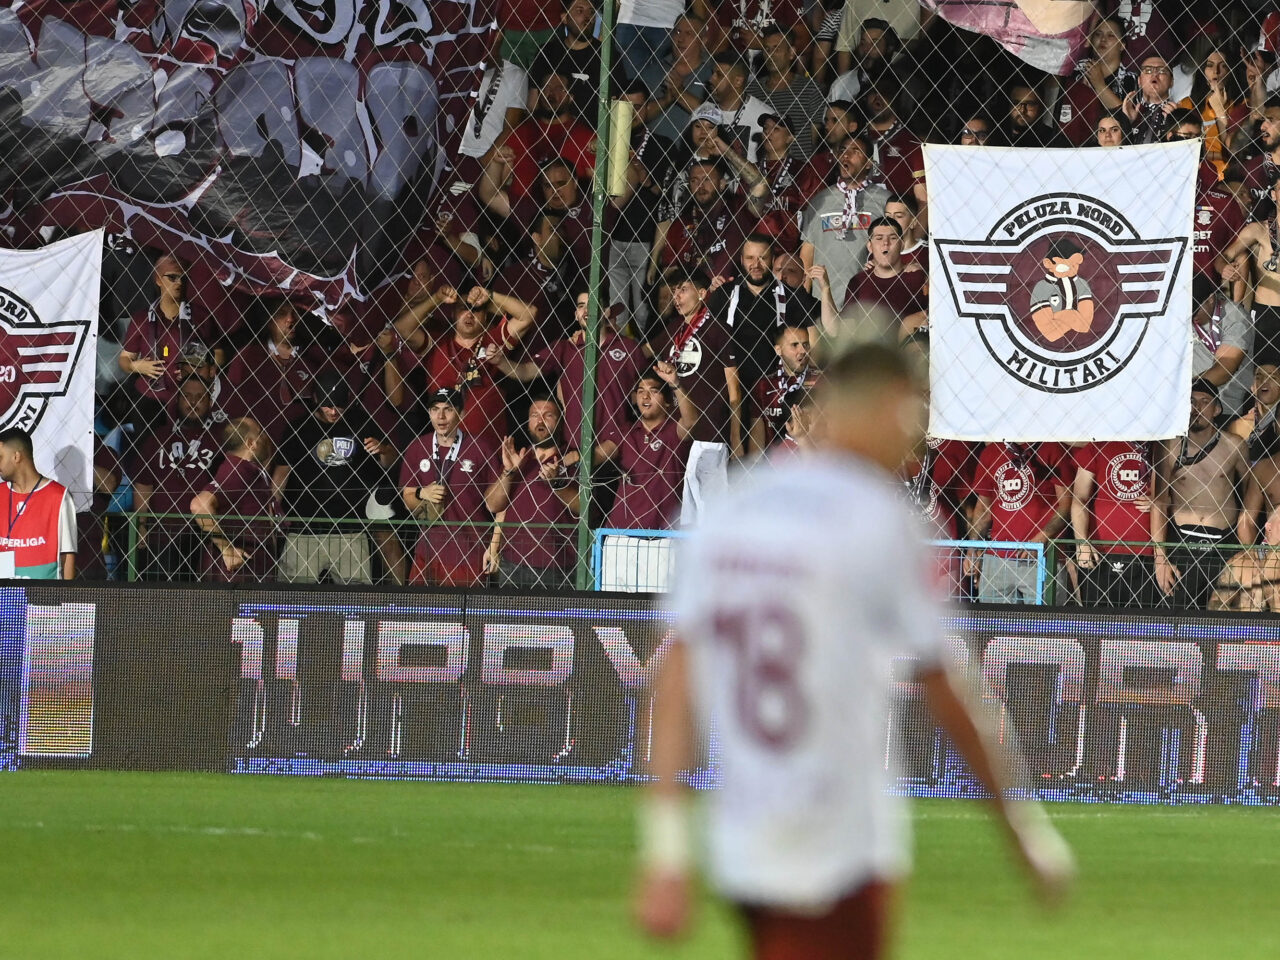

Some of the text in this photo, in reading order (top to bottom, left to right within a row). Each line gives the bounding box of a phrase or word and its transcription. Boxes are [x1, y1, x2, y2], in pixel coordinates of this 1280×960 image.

[1003, 200, 1124, 238] PELUZA NORD
[1006, 349, 1121, 388] MILITARI
